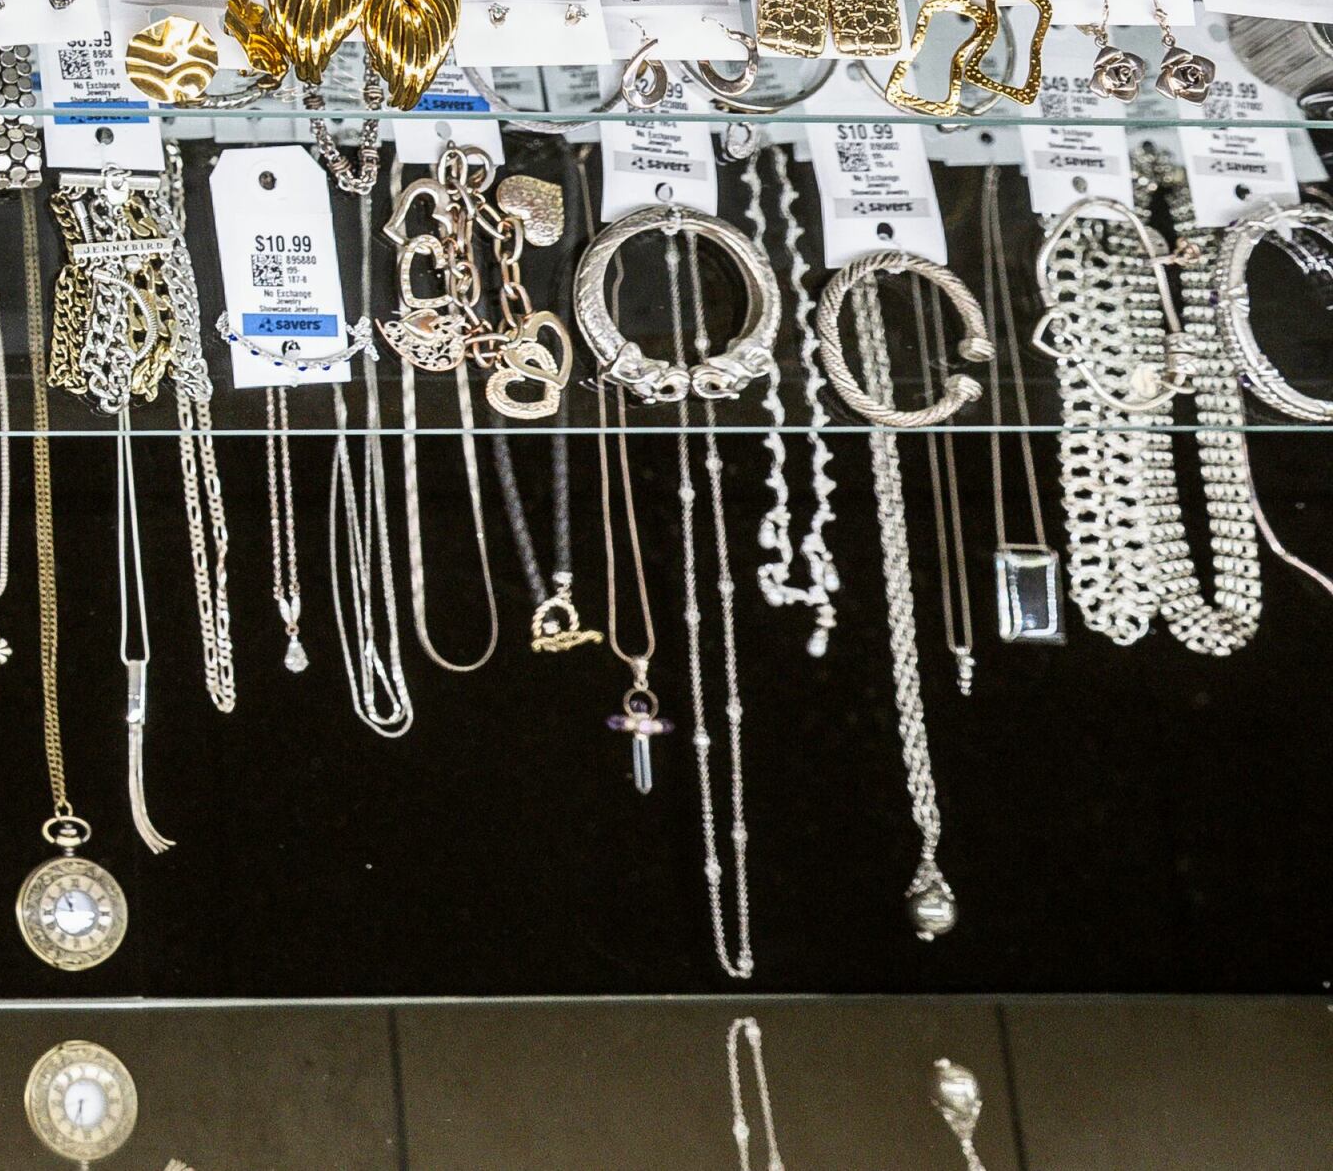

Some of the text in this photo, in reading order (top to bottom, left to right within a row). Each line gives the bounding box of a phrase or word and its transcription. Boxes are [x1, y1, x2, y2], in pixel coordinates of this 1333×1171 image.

[836, 123, 890, 140] $10.99
[84, 242, 164, 254] JENNYBIRD
[254, 234, 311, 252] $10.99
[275, 319, 322, 330] savers
